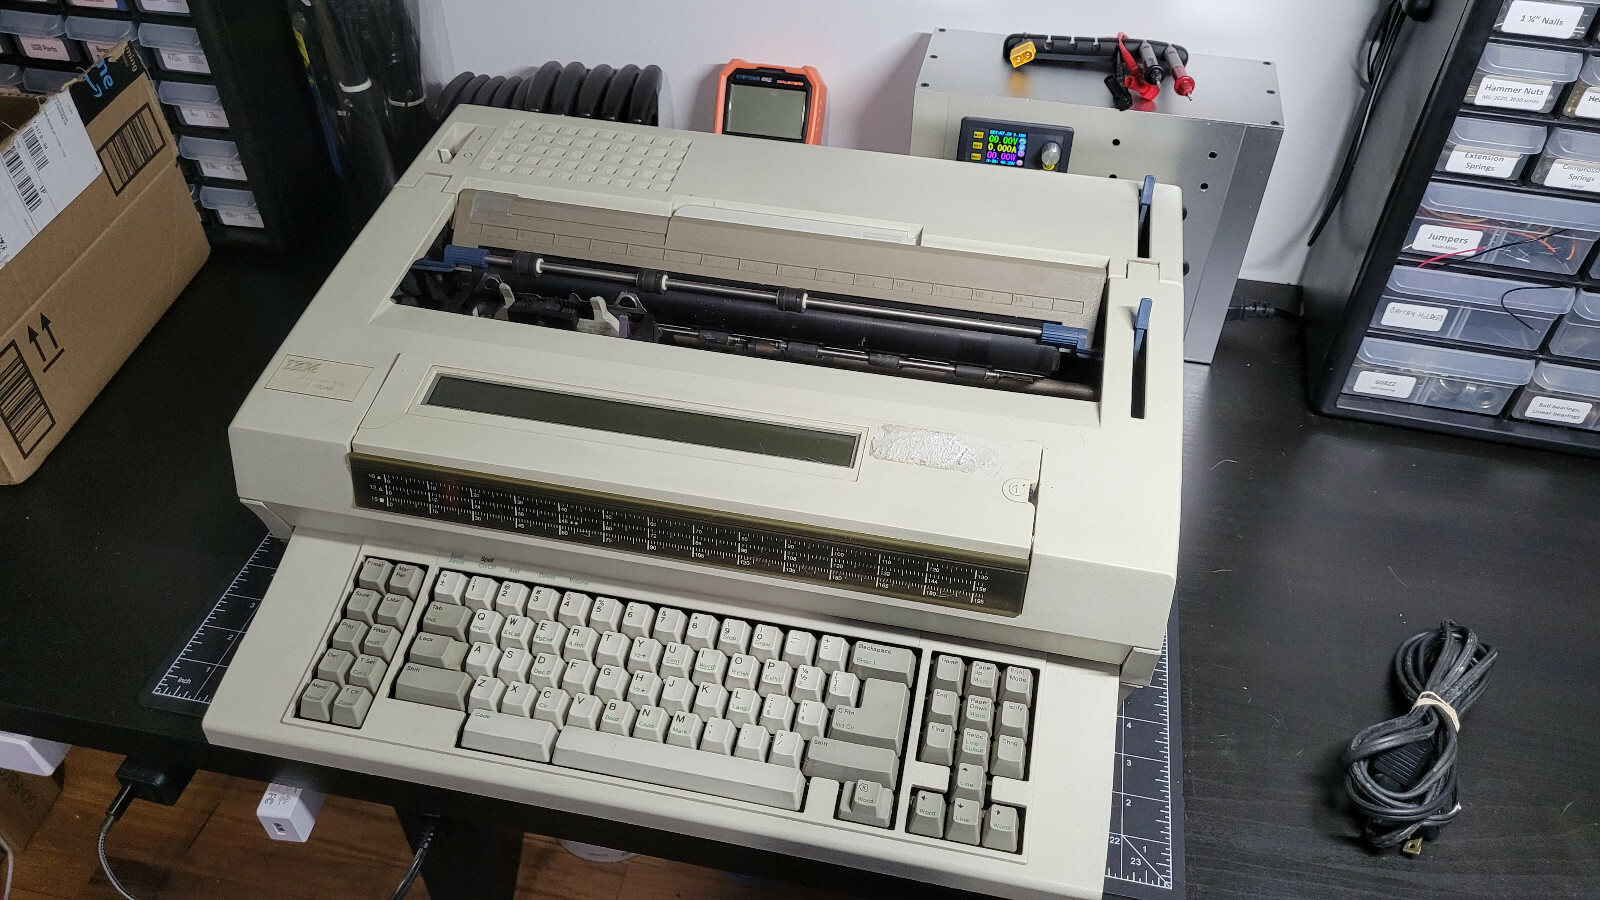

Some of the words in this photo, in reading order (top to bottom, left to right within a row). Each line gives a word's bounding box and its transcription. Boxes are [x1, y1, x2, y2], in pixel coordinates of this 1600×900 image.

[1542, 17, 1564, 26] Nails
[1485, 84, 1522, 93] Hammer
[989, 135, 1018, 144] 00.00V
[988, 143, 1016, 153] 0.000A
[987, 151, 1016, 161] 00.00W
[1465, 152, 1504, 162] Extension
[1465, 162, 1495, 172] Springs
[1568, 174, 1595, 182] Springs
[1428, 233, 1468, 244] Jumpers
[342, 621, 355, 630] Play
[540, 623, 547, 631] E
[669, 645, 676, 654] U
[858, 644, 892, 654] Backspace
[636, 673, 644, 681] H
[478, 679, 486, 687] Z
[510, 685, 519, 693] X
[702, 685, 710, 693] K
[735, 691, 741, 699] L
[578, 696, 586, 704] V
[732, 703, 747, 711] Lang
[676, 715, 685, 723] M
[1003, 738, 1017, 747] Chng
[1110, 836, 1120, 845] 22
[1130, 857, 1141, 866] 23
